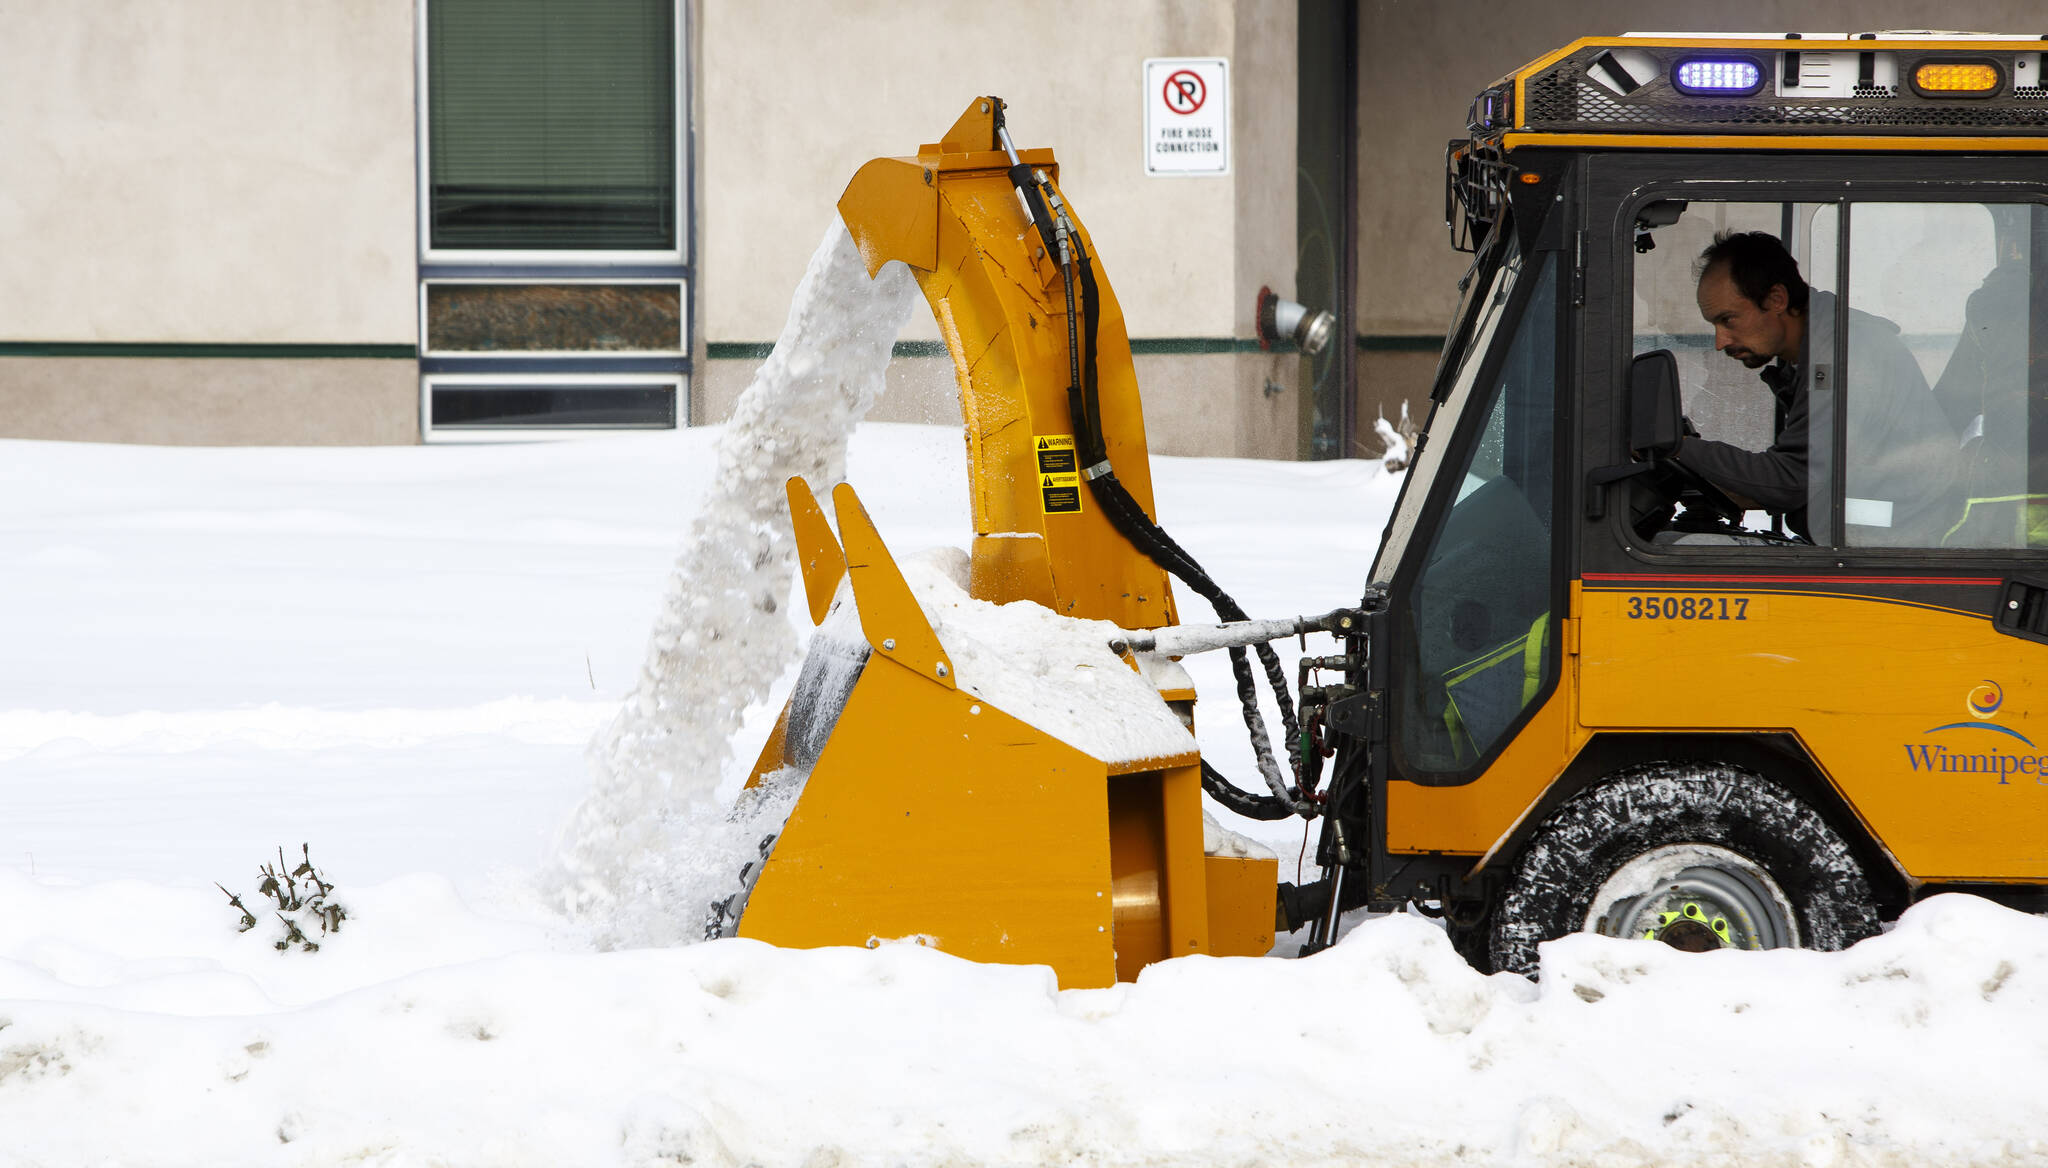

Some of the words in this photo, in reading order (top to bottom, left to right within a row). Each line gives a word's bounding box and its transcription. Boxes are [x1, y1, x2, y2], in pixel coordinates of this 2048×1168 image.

[1161, 127, 1183, 139] FIRE
[1187, 127, 1213, 139] HOSE
[1156, 142, 1219, 153] CONNECTION
[1048, 438, 1073, 446] WARNING
[1627, 596, 1750, 621] 3508217
[1903, 744, 2048, 786] Winnipeg
